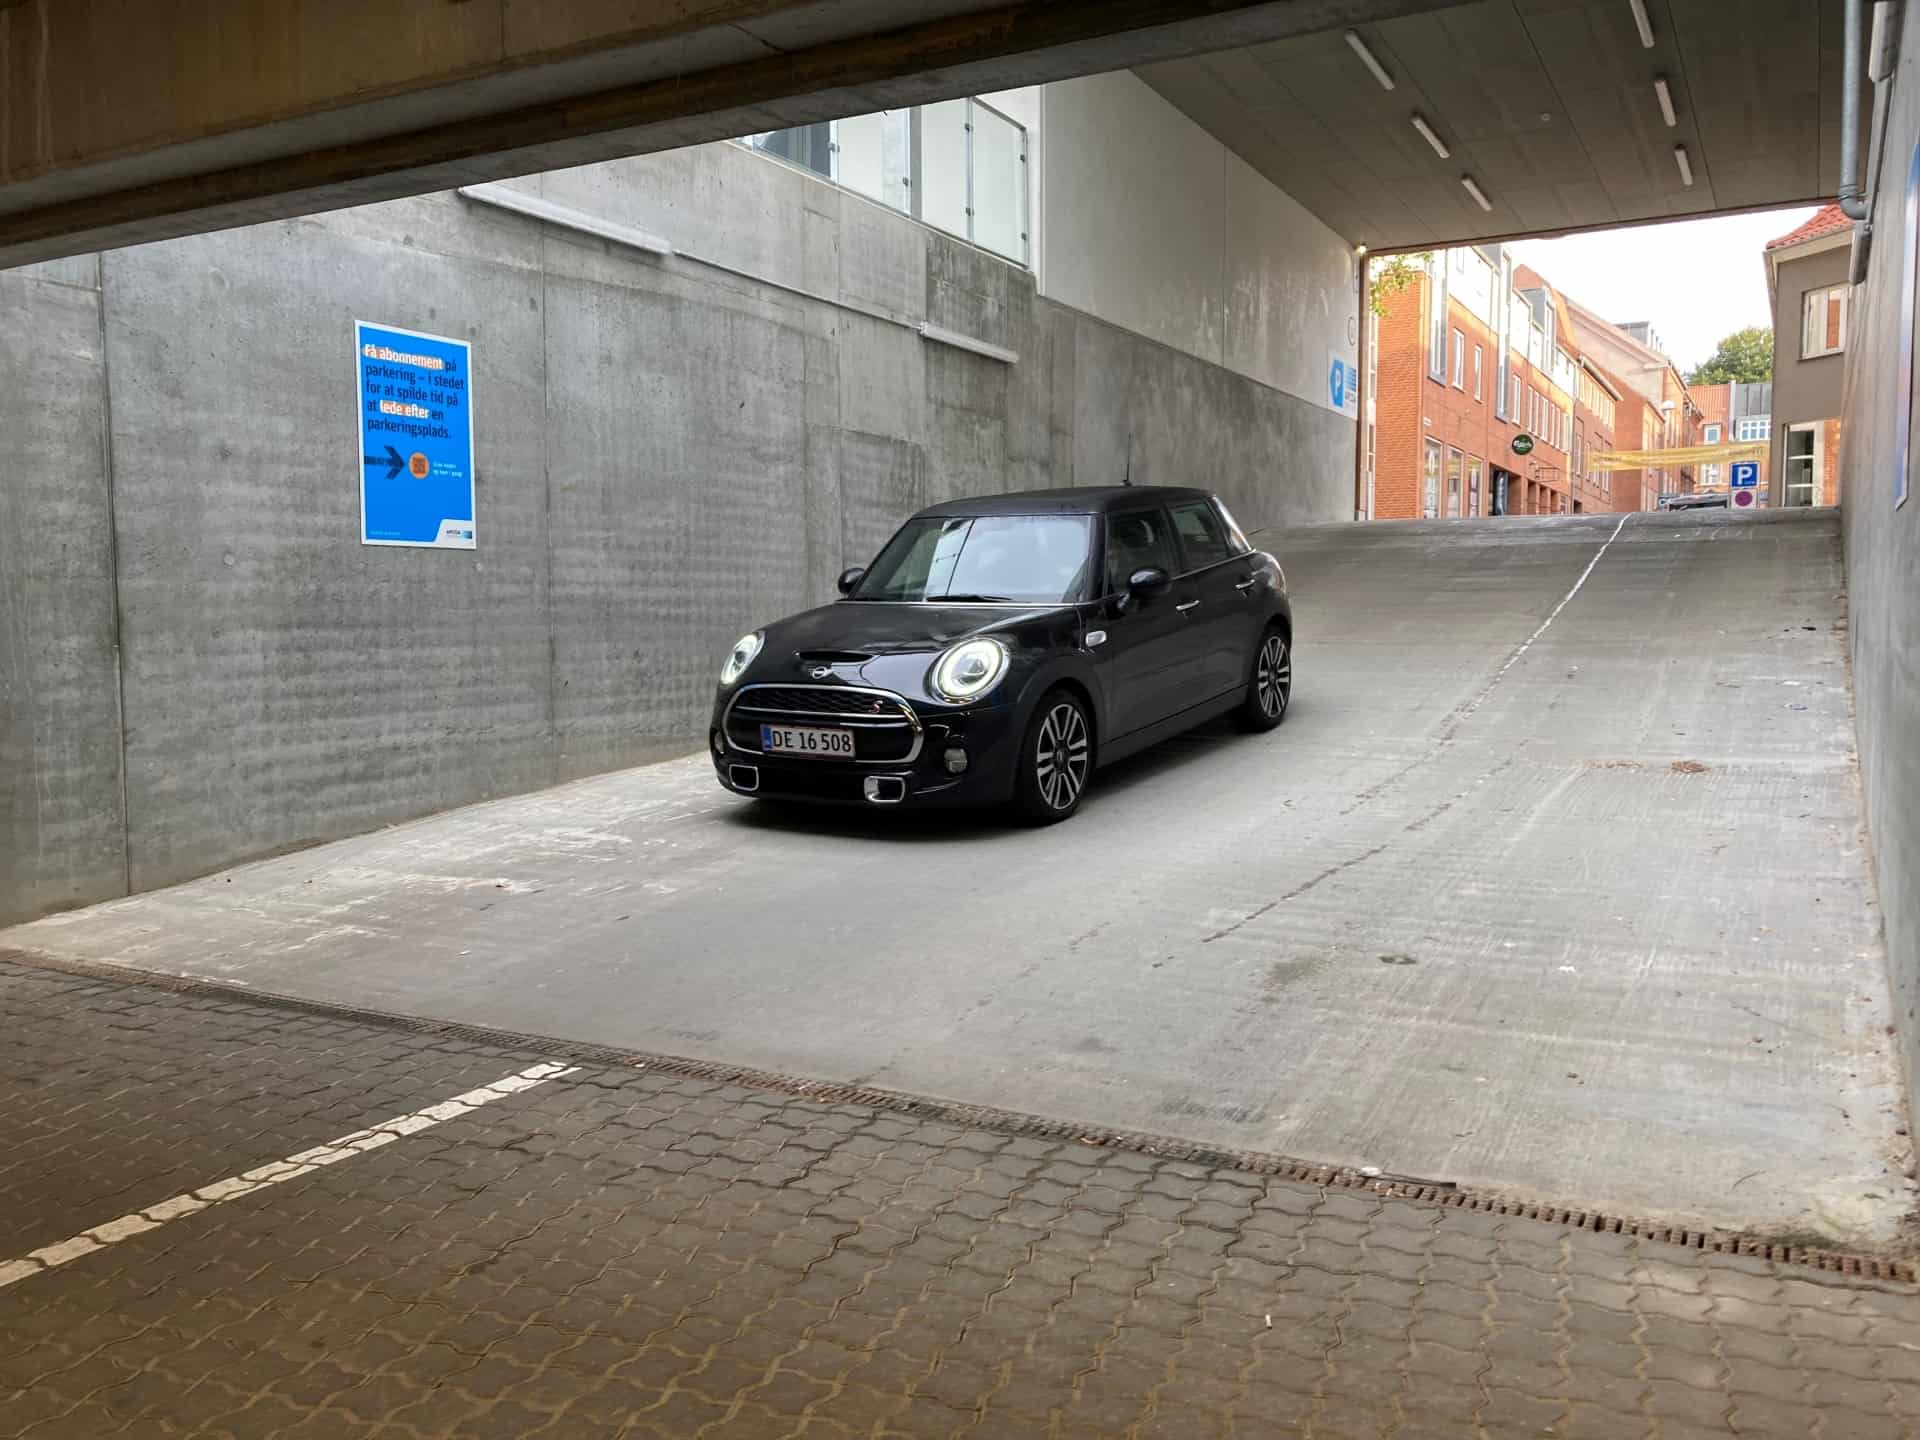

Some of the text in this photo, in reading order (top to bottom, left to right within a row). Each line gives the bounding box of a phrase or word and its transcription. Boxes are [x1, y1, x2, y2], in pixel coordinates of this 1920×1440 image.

[379, 347, 443, 370] abonnement
[445, 360, 457, 373] på
[365, 364, 416, 386] parkering
[432, 375, 465, 390] stedet
[366, 380, 459, 408] for at spilde tid på
[367, 400, 444, 420] at lede efter en
[1737, 466, 1753, 485] P
[772, 730, 852, 753] DE 16 508
